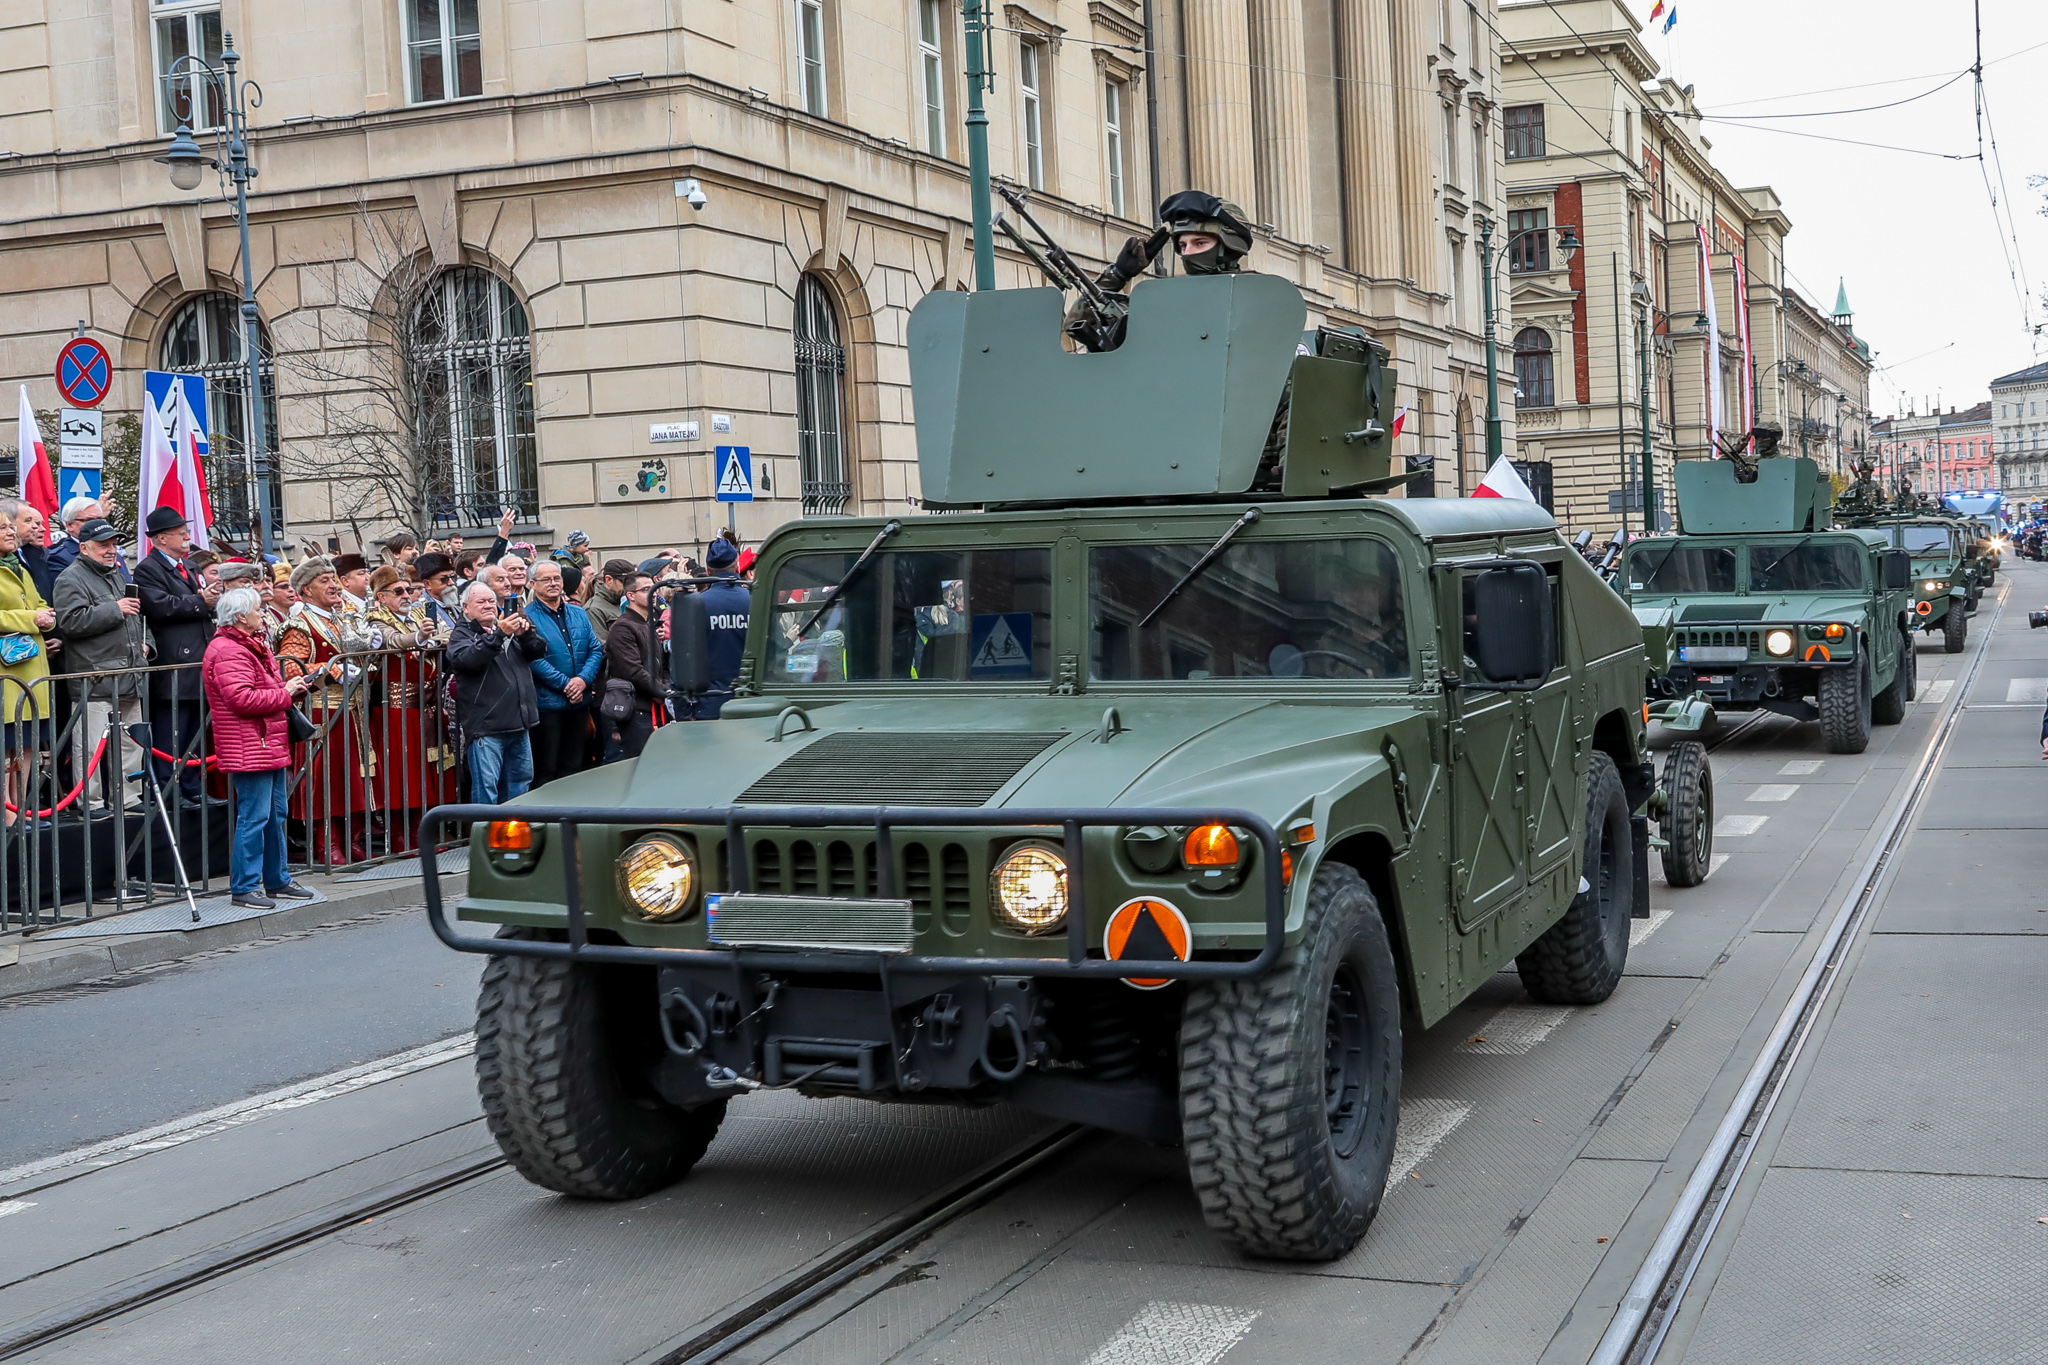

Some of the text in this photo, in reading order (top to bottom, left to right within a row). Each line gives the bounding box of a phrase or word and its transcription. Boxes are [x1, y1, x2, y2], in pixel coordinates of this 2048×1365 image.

[650, 430, 697, 440] JANA MATEJKI
[709, 614, 750, 630] POLICJ
